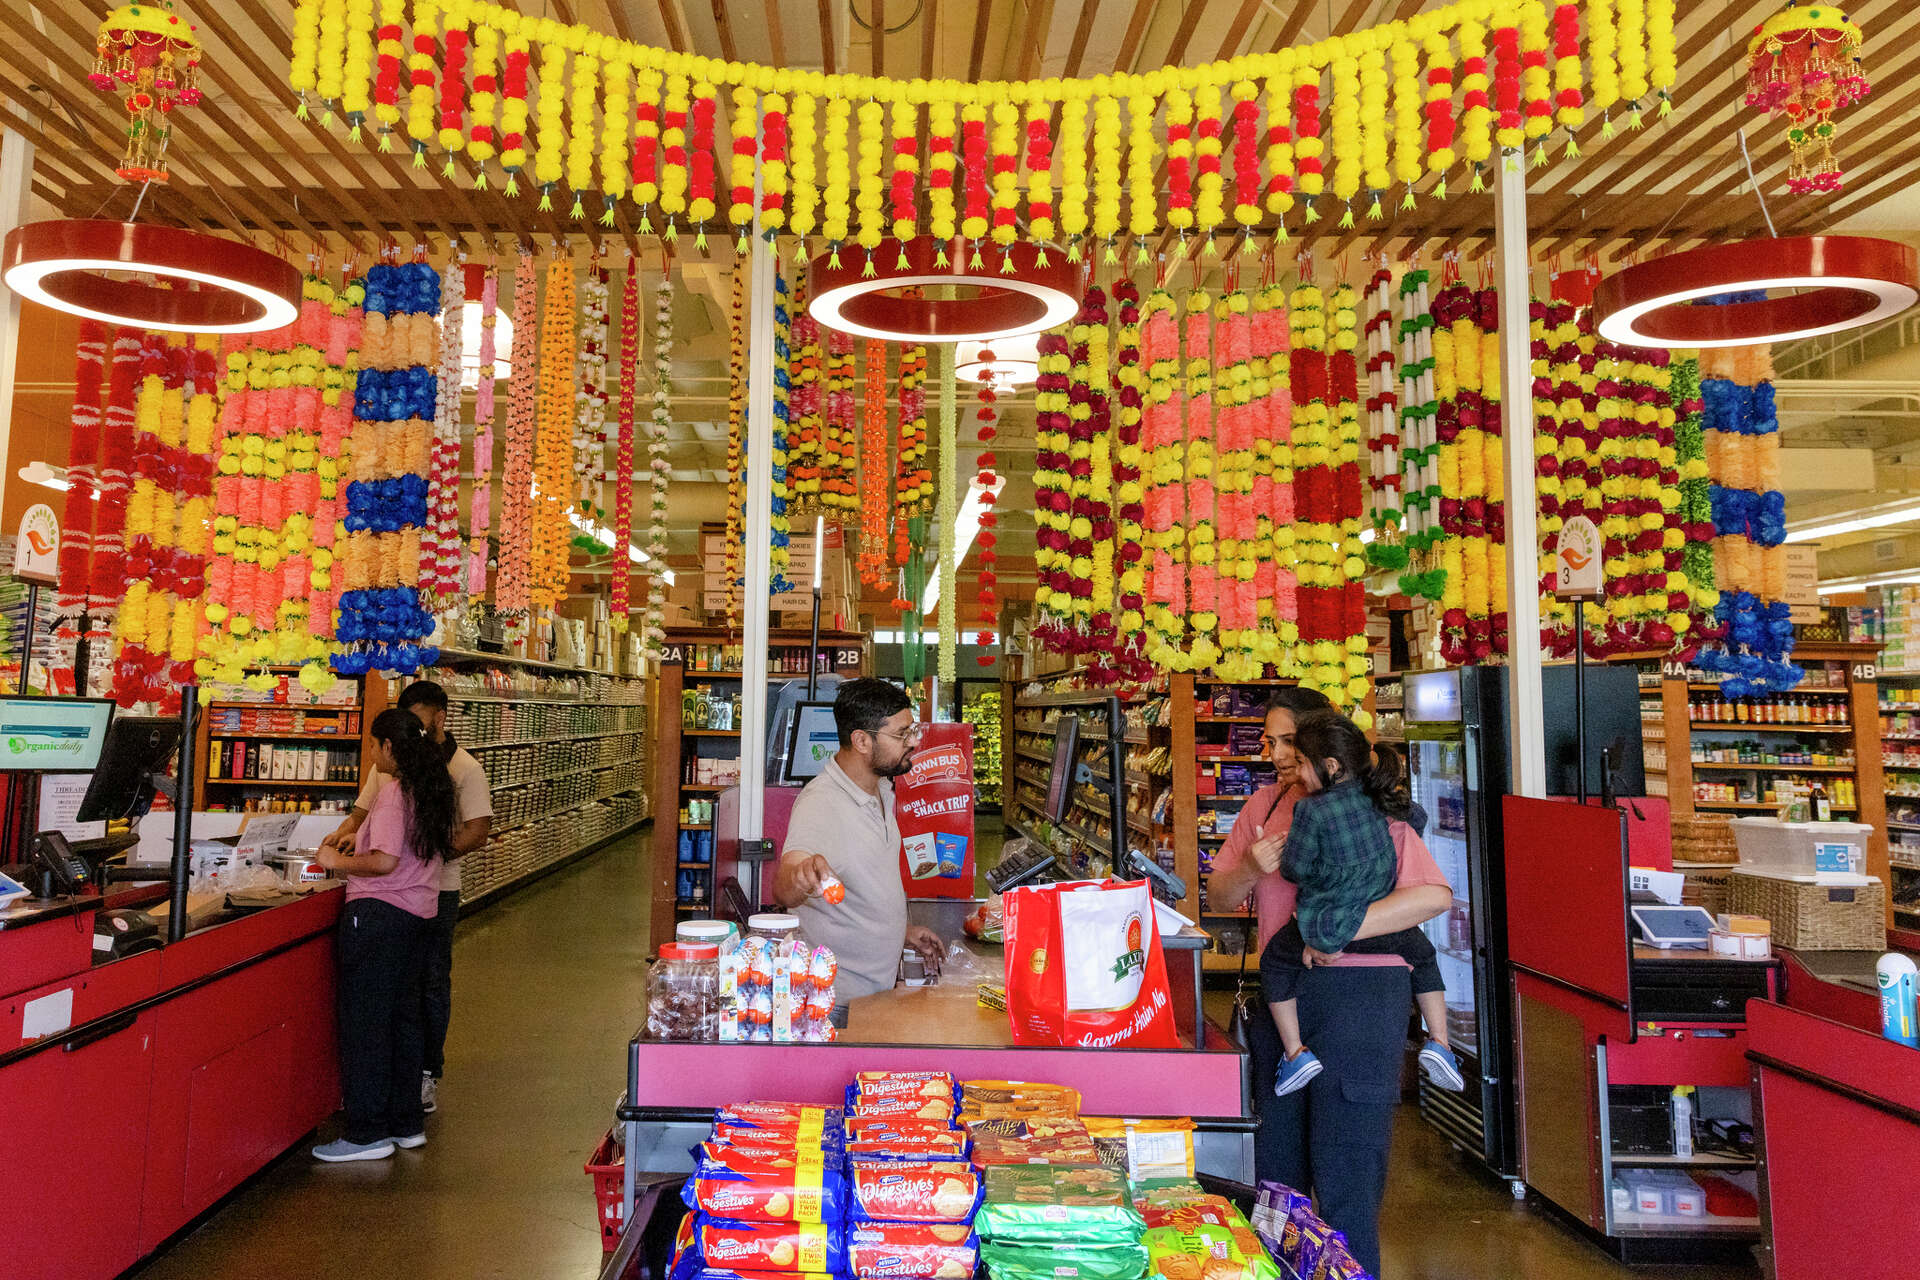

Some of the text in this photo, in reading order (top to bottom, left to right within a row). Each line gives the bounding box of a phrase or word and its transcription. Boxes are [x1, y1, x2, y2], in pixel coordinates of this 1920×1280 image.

[27, 550, 31, 566] 1
[1563, 567, 1570, 585] 3
[661, 647, 682, 661] 2A
[837, 651, 859, 664] 2B
[1664, 661, 1686, 676] 4A
[1853, 664, 1876, 679] 4B
[910, 755, 960, 776] TOWN BUS
[911, 800, 921, 808] ON
[921, 798, 926, 806] A
[914, 795, 970, 817] SNACK TRIP
[1078, 1020, 1133, 1047] Laxmi
[1152, 988, 1167, 1012] No
[1882, 995, 1893, 1027] Inhaler
[864, 1081, 921, 1096] Digestives
[860, 1101, 922, 1116] Digestives
[861, 1179, 934, 1201] Digestives
[702, 1195, 754, 1211] Digestives
[709, 1239, 760, 1261] Digestives
[859, 1262, 933, 1278] Digestives
